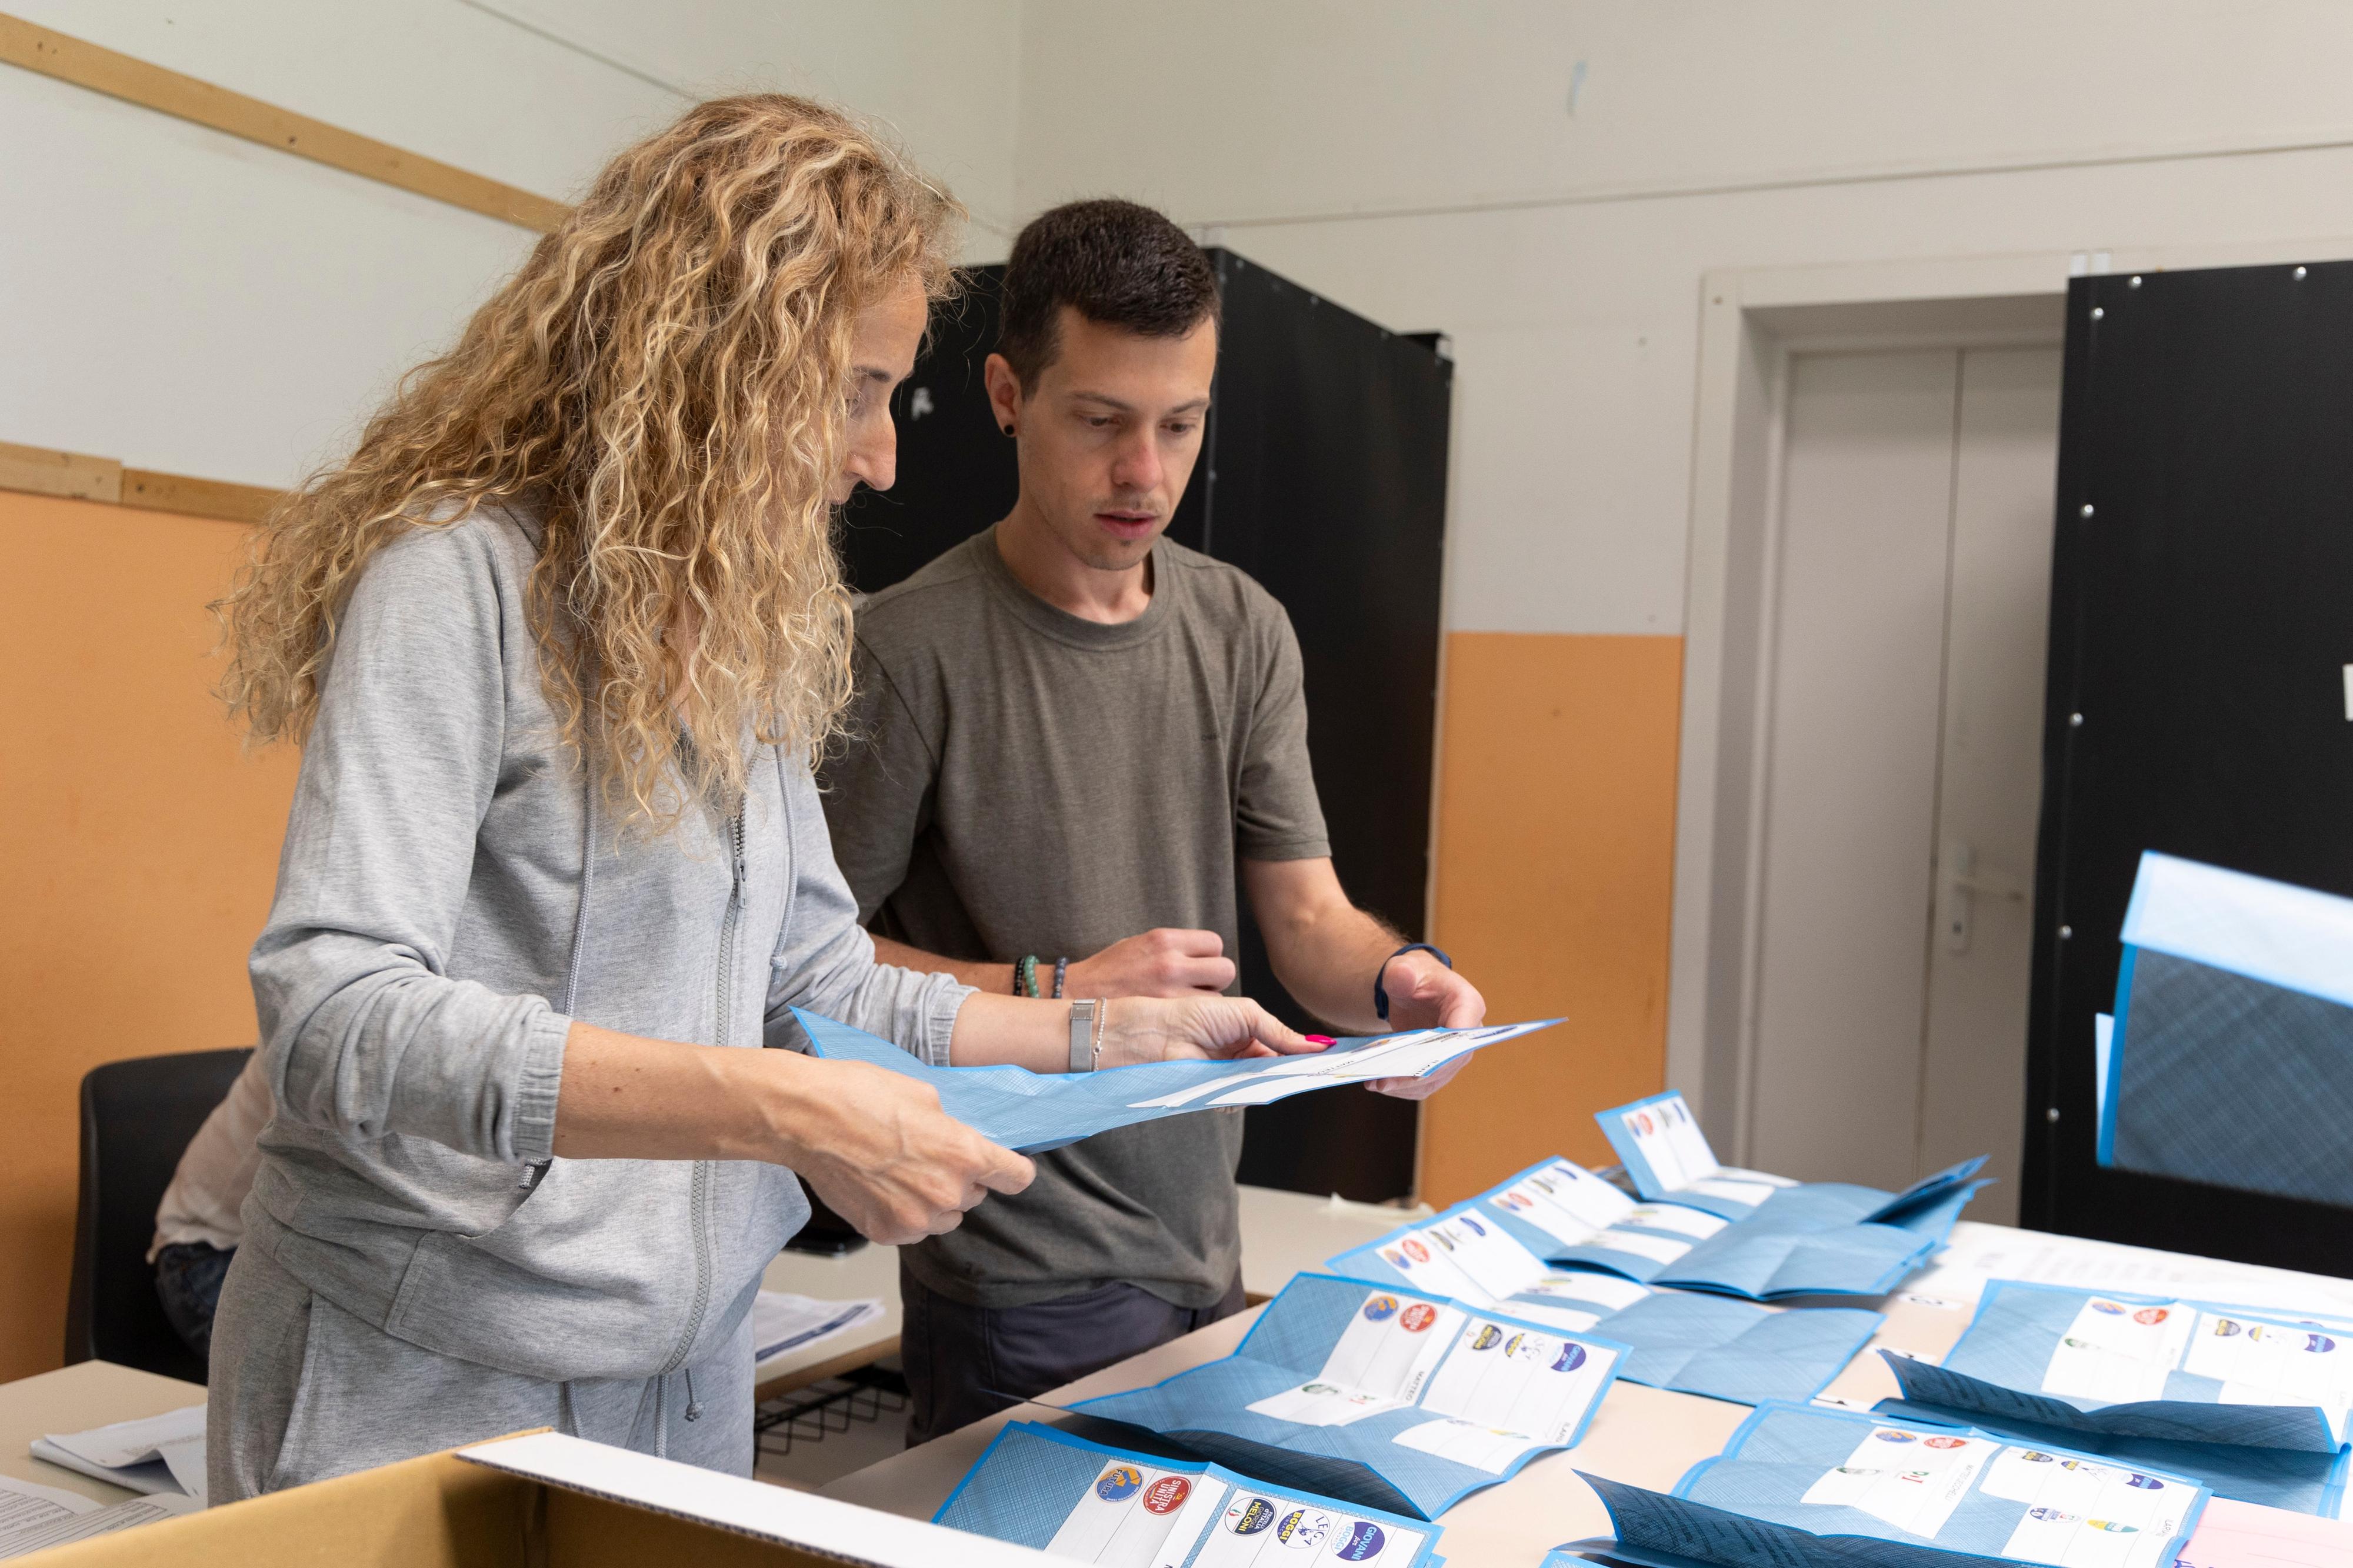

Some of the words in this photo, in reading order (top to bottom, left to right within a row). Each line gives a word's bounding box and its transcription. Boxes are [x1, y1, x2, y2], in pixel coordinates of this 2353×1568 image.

[1099, 1468, 1124, 1496] FUTURA
[1155, 1479, 1182, 1512] SINISTRA
[1238, 1501, 1261, 1532] MELONI
[1248, 1505, 1264, 1529] GIORGIA
[1260, 1511, 1274, 1530] FRATELLI
[1279, 1512, 1302, 1540] BOGGI
[1304, 1516, 1328, 1546] LEGA
[1334, 1526, 1354, 1550] BOGGI
[1351, 1526, 1378, 1560] GIOVANI
